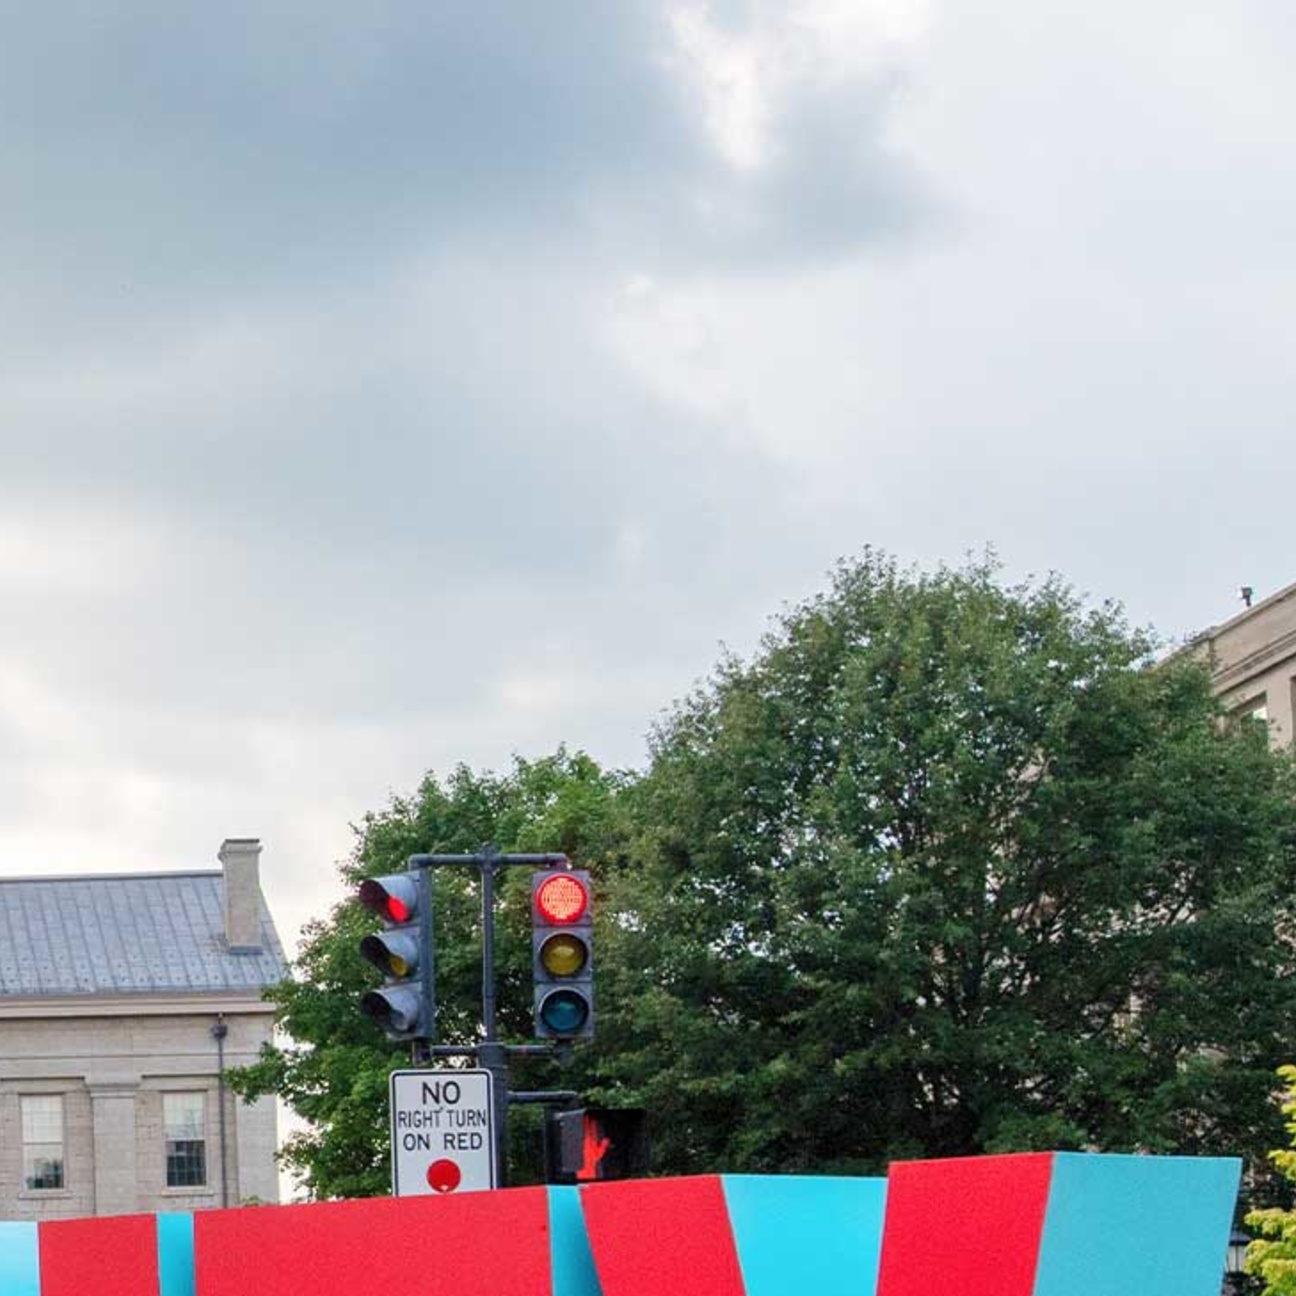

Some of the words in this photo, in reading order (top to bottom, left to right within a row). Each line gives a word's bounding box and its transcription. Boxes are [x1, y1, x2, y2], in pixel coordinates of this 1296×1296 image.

[422, 1081, 461, 1105] NO
[398, 1110, 441, 1128] RIGHT
[447, 1109, 486, 1127] TURN
[403, 1133, 430, 1151] ON
[443, 1132, 482, 1150] RED
